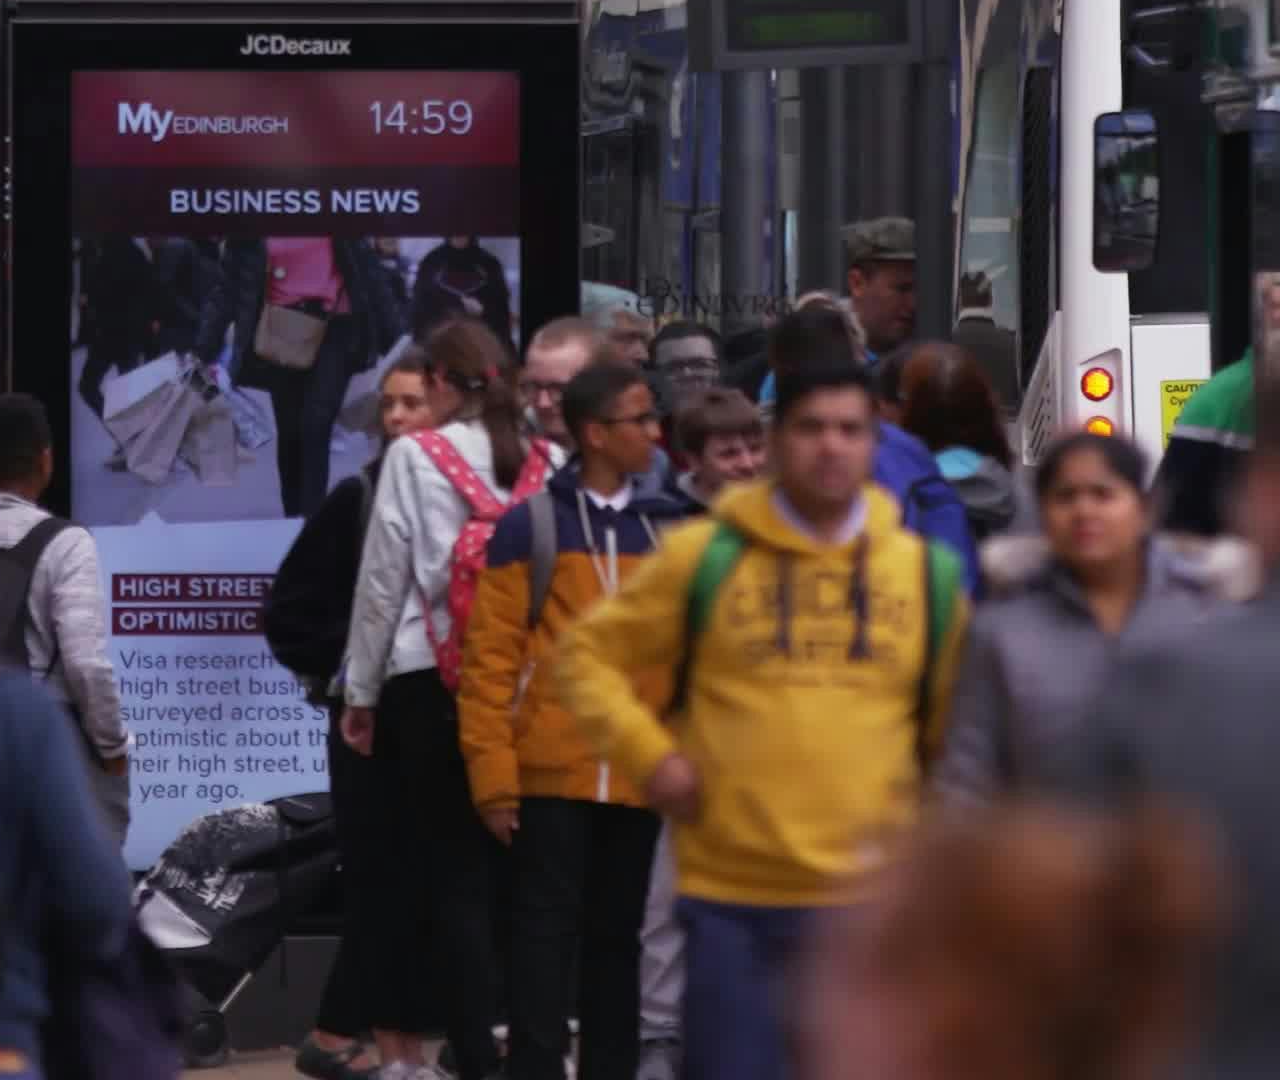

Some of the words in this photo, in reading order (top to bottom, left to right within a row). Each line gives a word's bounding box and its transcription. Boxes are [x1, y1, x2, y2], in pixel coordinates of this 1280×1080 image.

[240, 34, 352, 57] JCDecaux
[369, 100, 473, 136] 14:59
[170, 189, 322, 214] BUSINESS
[330, 189, 421, 214] NEWS
[1165, 383, 1202, 393] CAUTI
[120, 578, 180, 597] HIGH
[119, 611, 257, 631] OPTIMISTIC
[120, 650, 168, 670] Visa
[175, 649, 273, 670] research
[120, 677, 168, 700] high
[175, 678, 241, 696] street
[119, 703, 223, 726] surveyed
[231, 705, 305, 721] across
[132, 728, 228, 750] ptimistic
[234, 728, 301, 748] about
[128, 754, 171, 773] heir
[177, 754, 226, 778] high
[233, 755, 305, 775] street,
[138, 784, 189, 804] year
[195, 784, 245, 804] ago.
